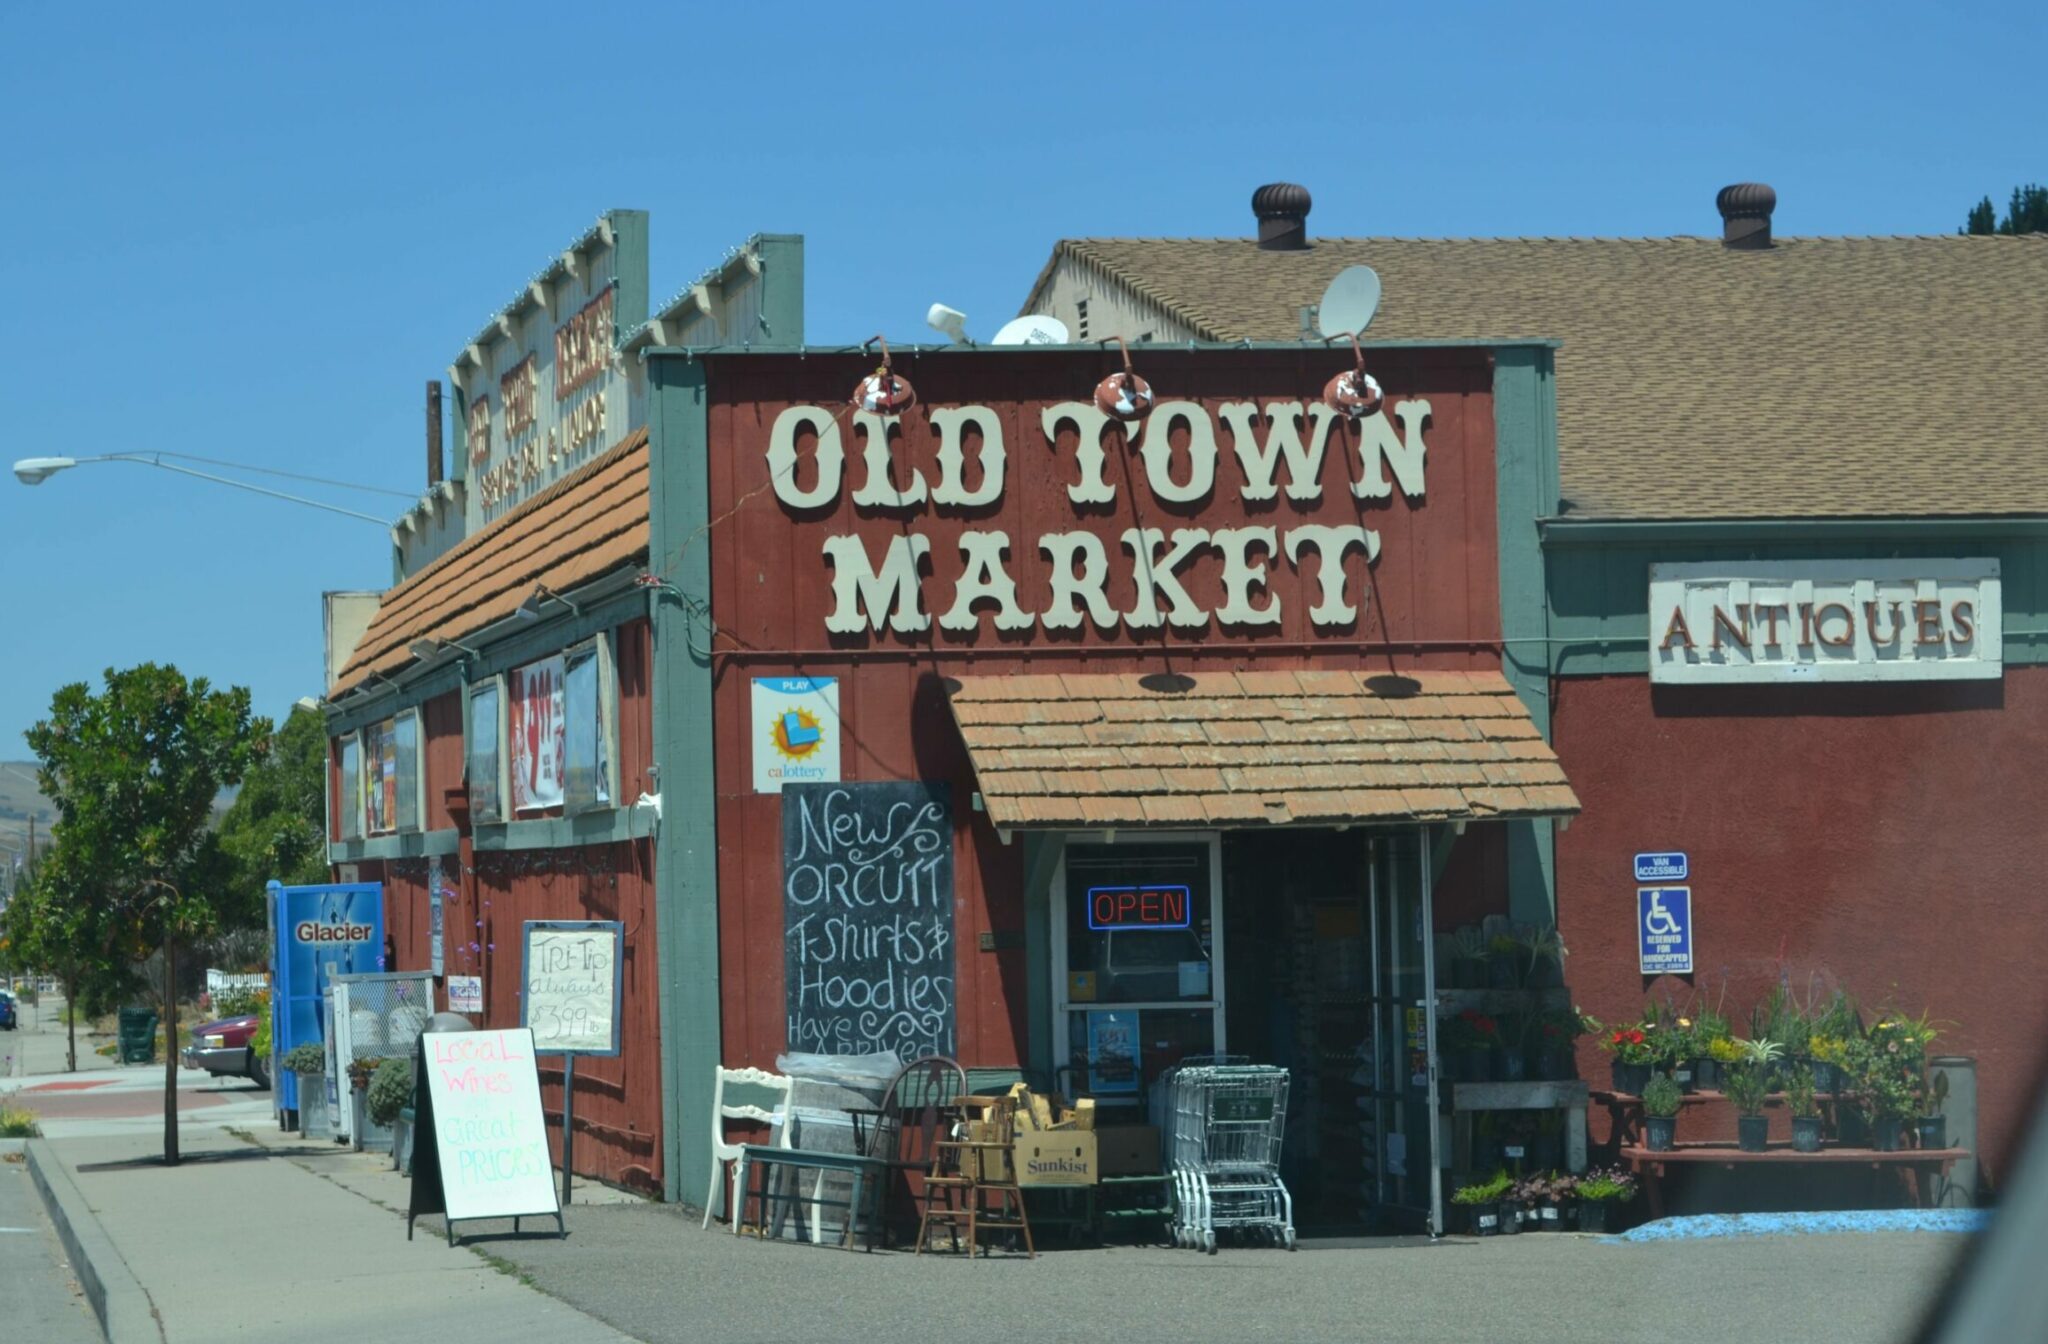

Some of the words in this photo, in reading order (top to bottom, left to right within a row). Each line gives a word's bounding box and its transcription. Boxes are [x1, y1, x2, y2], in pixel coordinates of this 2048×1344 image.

[766, 402, 1006, 508] OLD
[1041, 399, 1432, 504] TOWN
[822, 524, 1381, 634] MARKET
[1658, 599, 1974, 650] ANTIQUES
[782, 681, 809, 691] PLAY
[768, 763, 827, 781] calottery
[792, 789, 912, 862] New
[1638, 865, 1684, 876] ACCESSIBLE
[1652, 857, 1670, 866] VAN
[787, 854, 944, 908] ORCUTT
[1095, 892, 1183, 923] OPEN
[297, 922, 372, 942] Glacier
[1647, 934, 1682, 944] RESERVED
[1643, 953, 1688, 963] HANDICAPPED
[1656, 944, 1671, 953] FOR
[799, 958, 953, 1016] Hoodies
[788, 1010, 851, 1045] Have
[1027, 1157, 1088, 1175] Sunkist
